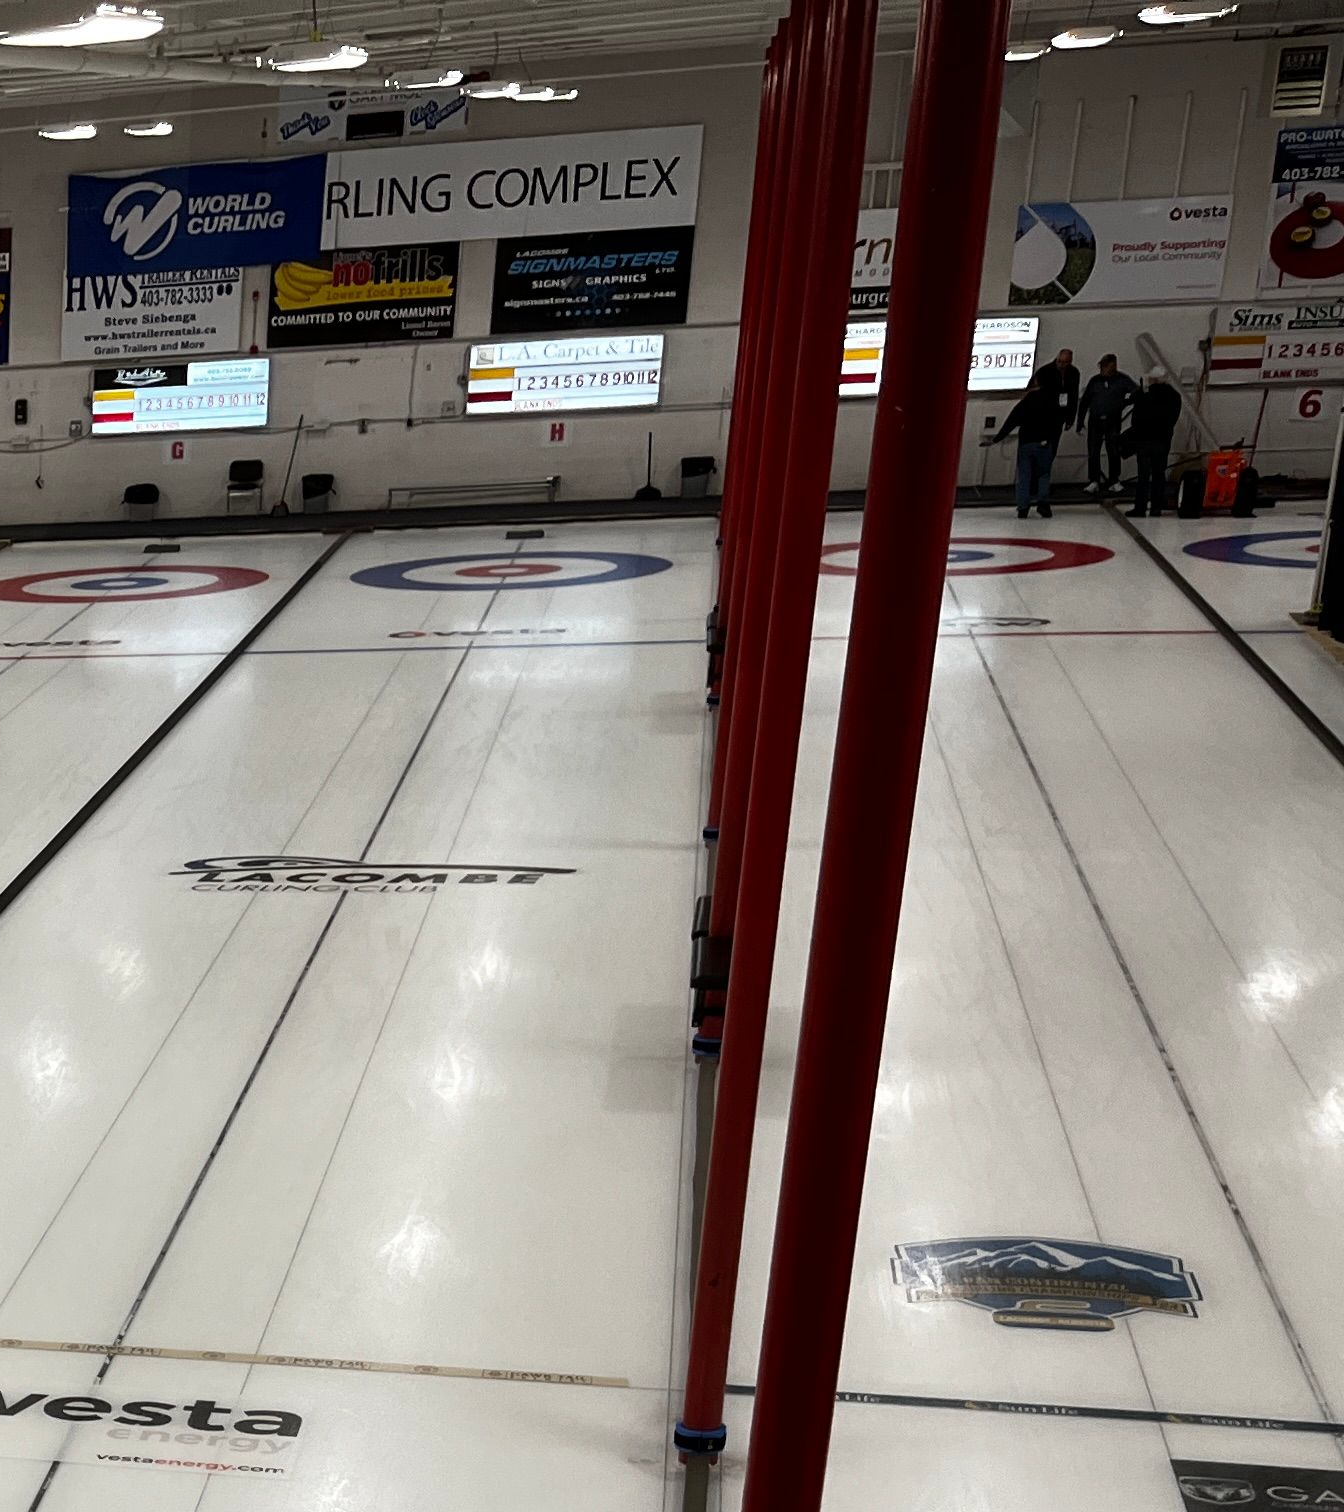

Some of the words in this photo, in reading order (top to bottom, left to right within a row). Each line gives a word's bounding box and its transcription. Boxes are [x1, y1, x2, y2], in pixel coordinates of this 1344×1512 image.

[467, 157, 681, 209] COMPLEX
[188, 193, 271, 215] WORLD
[1184, 205, 1228, 220] vesta
[187, 211, 285, 235] CURLING
[1112, 241, 1157, 253] Proudly
[1160, 238, 1227, 251] Supporting
[507, 250, 680, 275] SIGNMASTERS
[1111, 255, 1131, 264] Our
[1134, 253, 1159, 263] Local
[1162, 251, 1223, 261] Community
[532, 275, 567, 289] SIGNS
[585, 274, 647, 286] GRAPHICS
[65, 274, 138, 313] HWS
[141, 285, 214, 308] 403-782-3333
[271, 312, 334, 327] COMMITTED
[338, 311, 353, 323] TO
[356, 308, 380, 321] OUR
[383, 305, 453, 320] COMMUNITY
[1230, 309, 1284, 327] Sims
[498, 346, 537, 361] L.A.
[543, 342, 600, 361] Carpet
[606, 341, 619, 355] &
[624, 338, 659, 354] Tile
[1299, 389, 1323, 418] 6
[550, 423, 565, 441] H
[170, 441, 185, 461] G
[196, 871, 548, 885] LACOMBE
[105, 1425, 294, 1456] energy
[96, 1450, 288, 1478] vestaenergy.com
